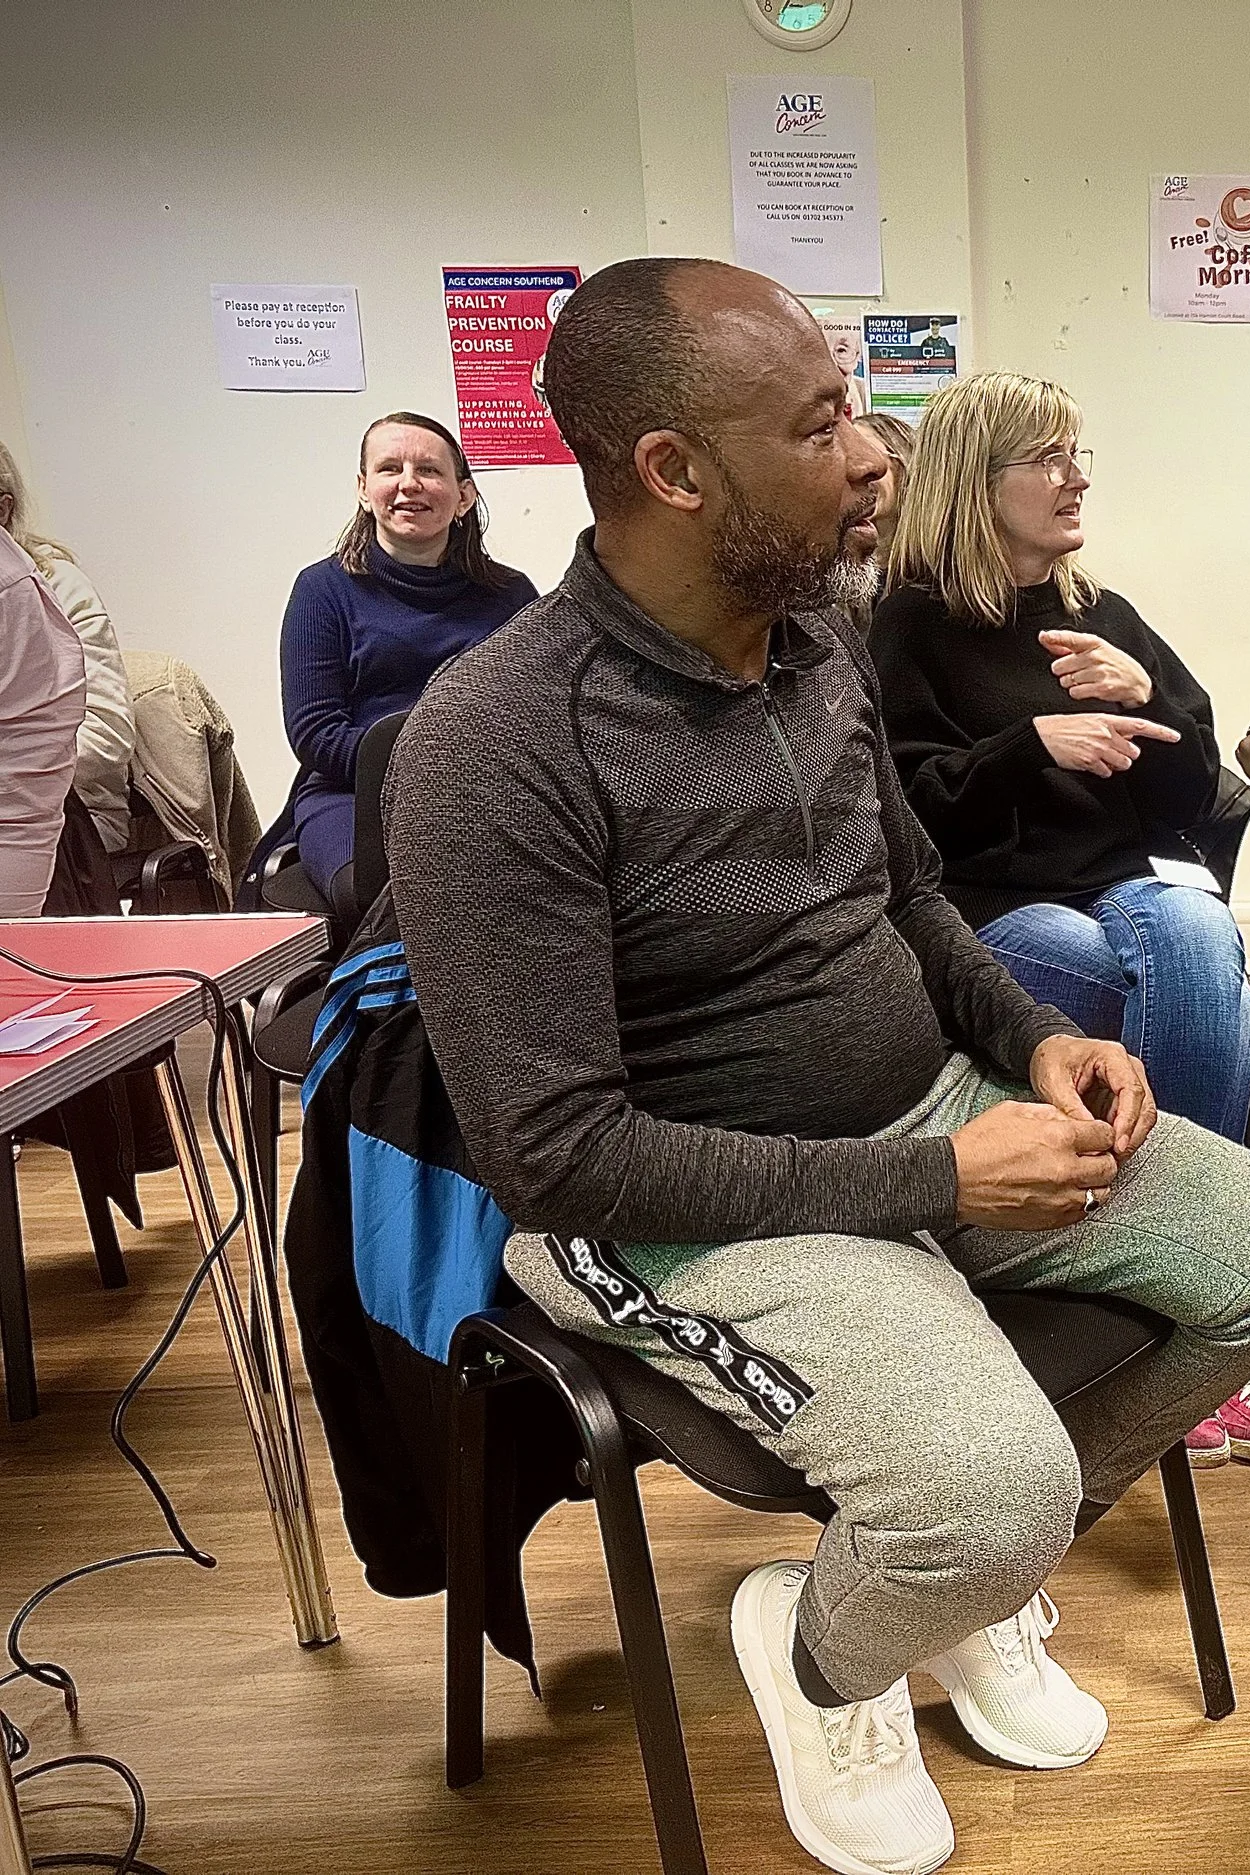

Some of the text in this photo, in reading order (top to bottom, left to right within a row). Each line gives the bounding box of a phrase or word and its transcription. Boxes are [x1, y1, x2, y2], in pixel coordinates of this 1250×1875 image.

[776, 94, 824, 112] AGE
[776, 112, 826, 134] Concern
[1165, 176, 1188, 186] AGE
[1170, 230, 1209, 250] Free!
[448, 277, 563, 286] AGE CONCERN SOUTHEND
[225, 301, 345, 314] Please pay at reception
[446, 296, 507, 309] FRAILTY
[237, 317, 336, 330] before you do your
[449, 317, 546, 330] PREVENTION
[274, 334, 302, 344] class.
[869, 334, 908, 343] POLICE?
[451, 340, 514, 352] COURSE
[248, 356, 306, 368] Thank you.
[458, 401, 527, 409] SUPPORTING,
[460, 420, 514, 428] IMPROVING
[570, 1238, 624, 1296] adidas
[743, 1360, 796, 1415] adidas
